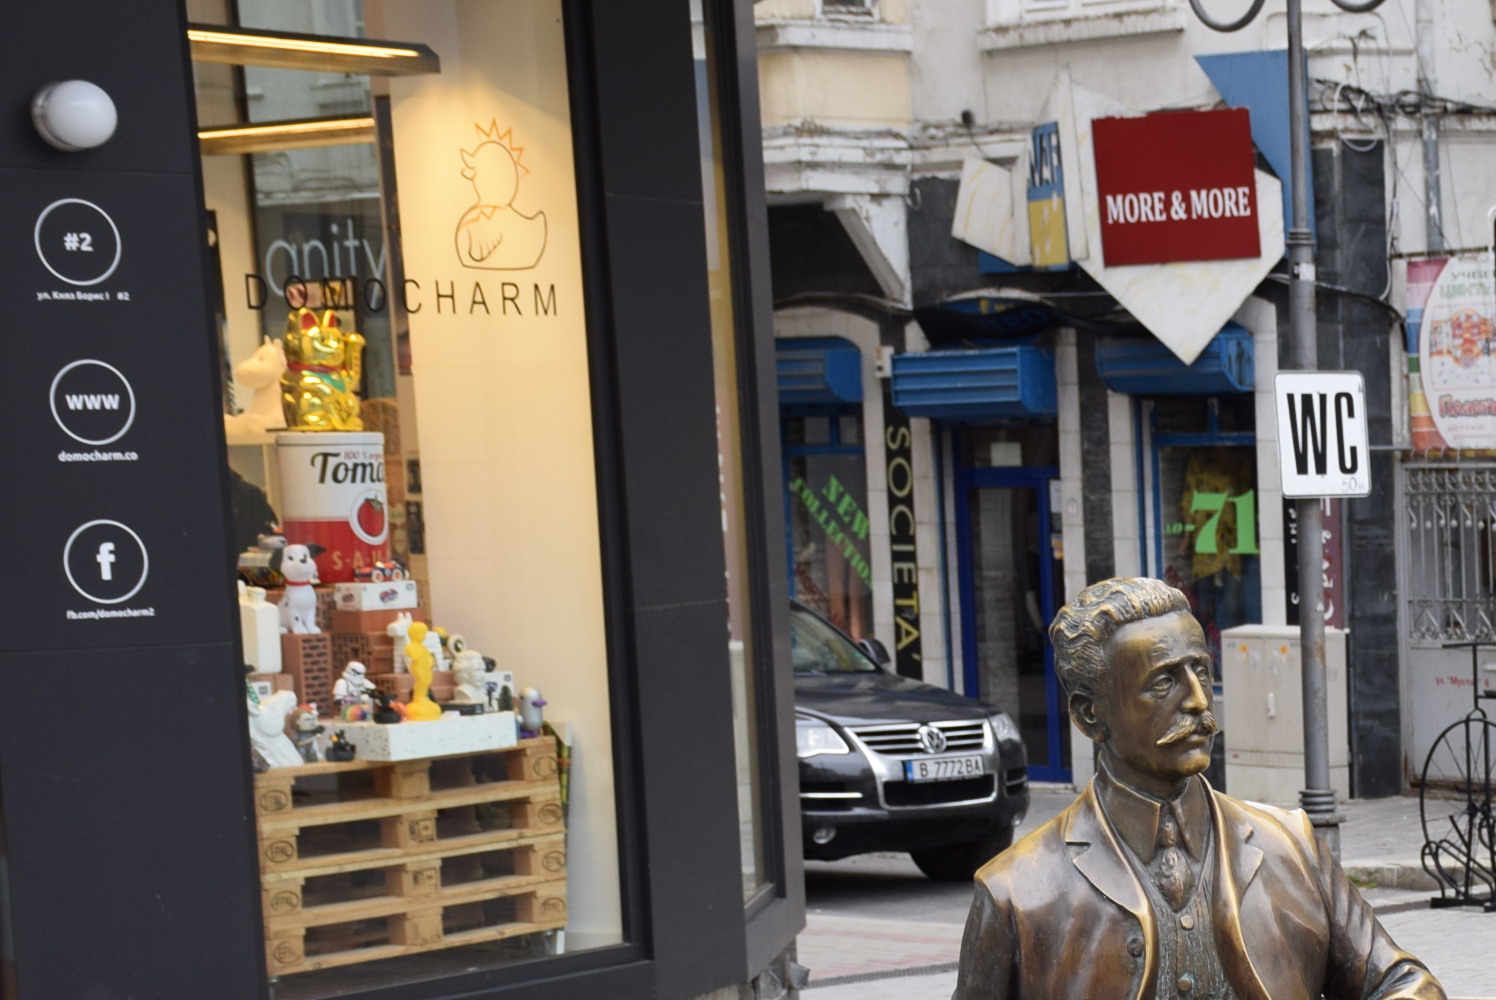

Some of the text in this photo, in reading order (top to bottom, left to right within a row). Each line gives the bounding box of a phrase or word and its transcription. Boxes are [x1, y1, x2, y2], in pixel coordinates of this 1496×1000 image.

[1105, 186, 1251, 225] MORE & MORE
[63, 232, 94, 252] #2
[244, 273, 558, 317] DOMOCHARM
[1286, 391, 1359, 475] WC
